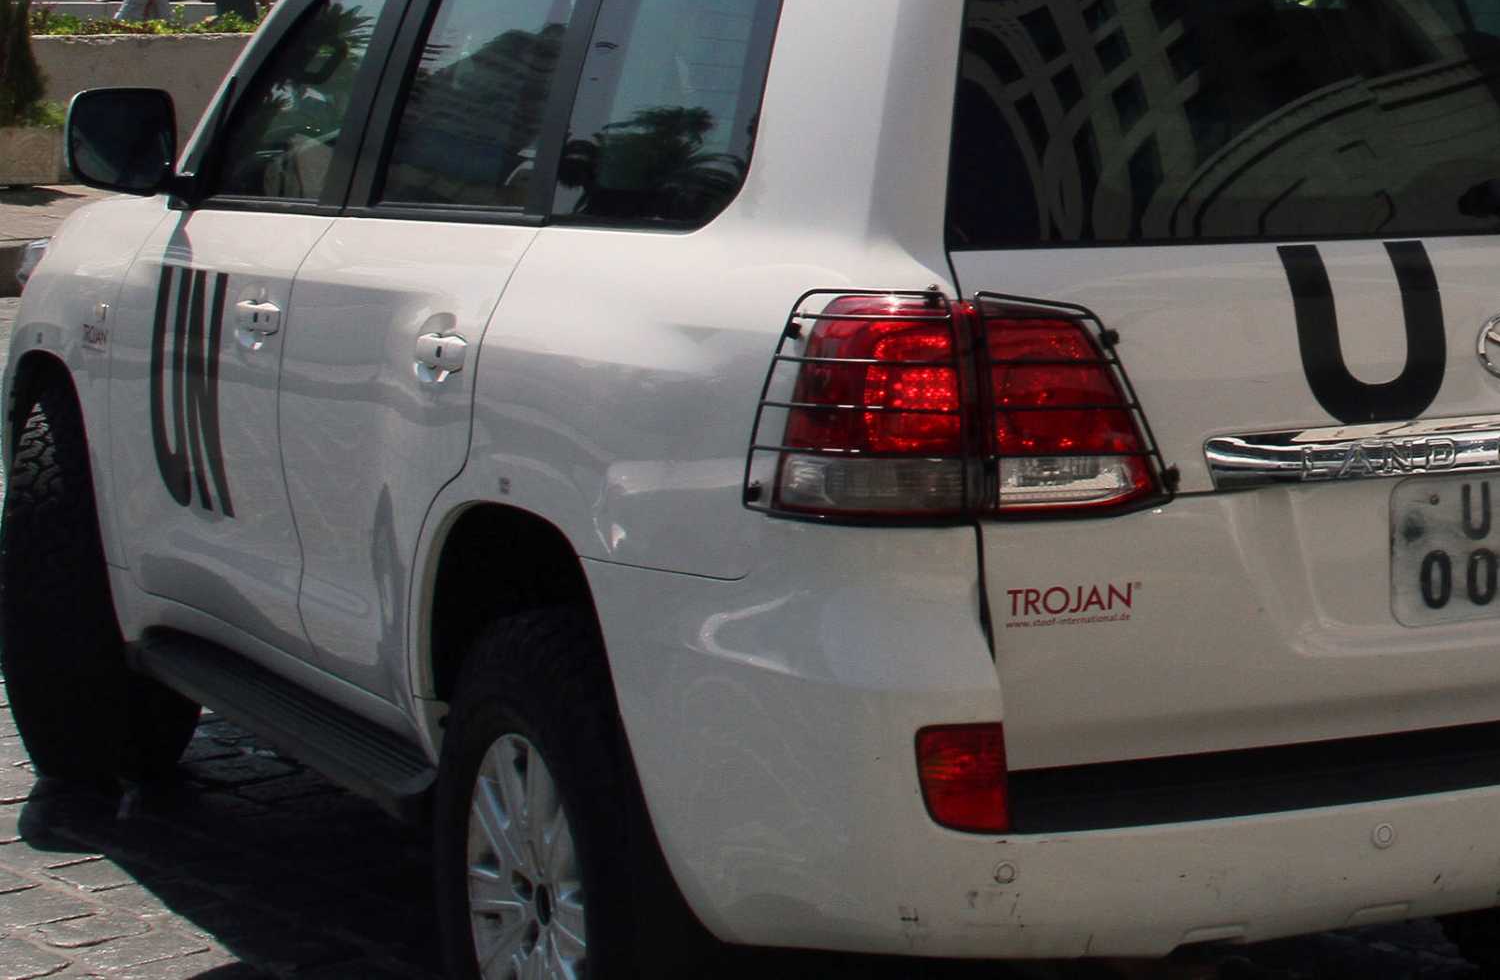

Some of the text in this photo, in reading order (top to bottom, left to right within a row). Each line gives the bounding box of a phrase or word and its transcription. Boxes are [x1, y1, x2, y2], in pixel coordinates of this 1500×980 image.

[151, 265, 235, 518] UN
[1300, 437, 1458, 481] LAND
[1007, 582, 1133, 616] TROJAN
